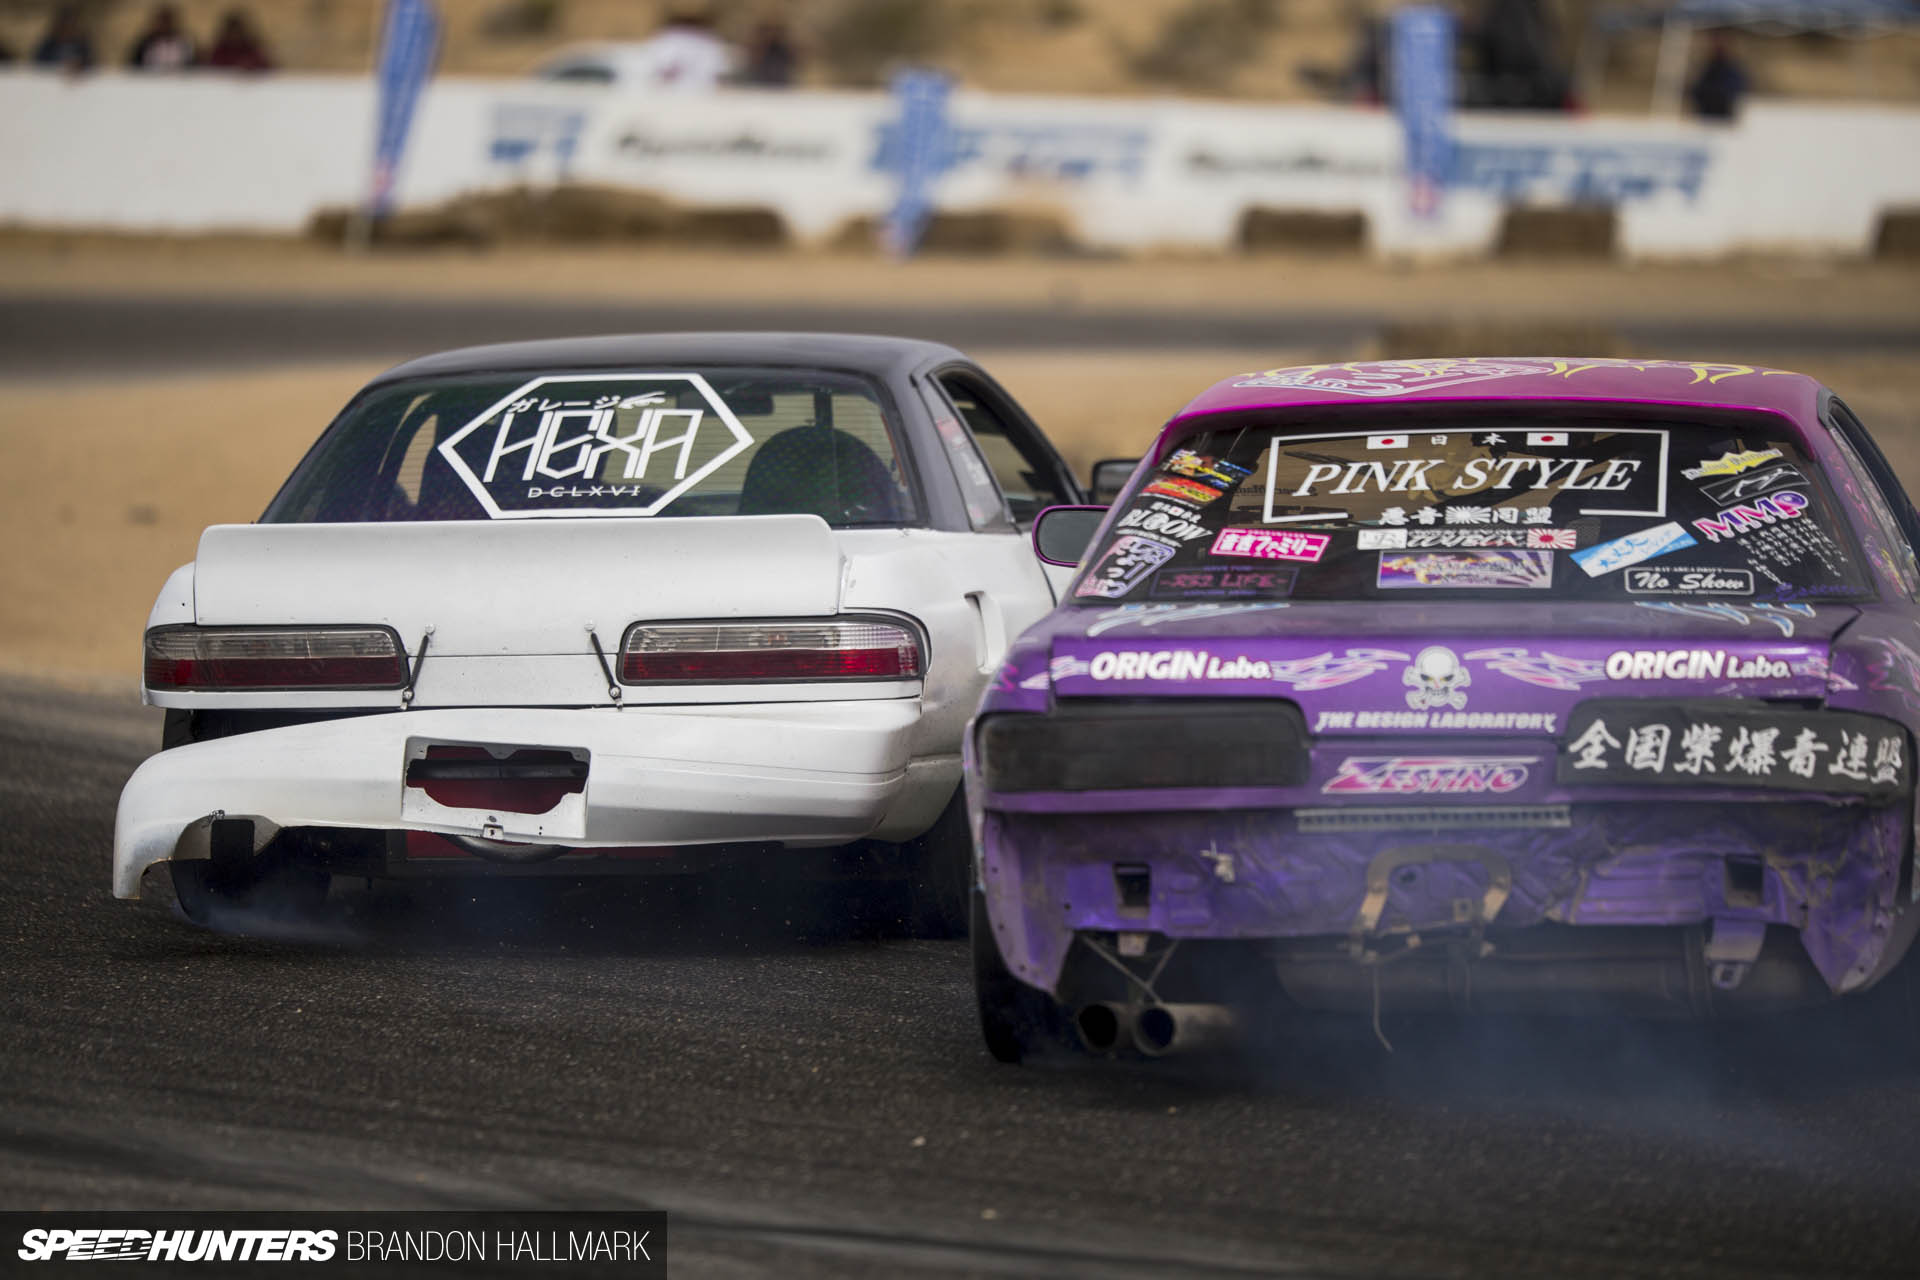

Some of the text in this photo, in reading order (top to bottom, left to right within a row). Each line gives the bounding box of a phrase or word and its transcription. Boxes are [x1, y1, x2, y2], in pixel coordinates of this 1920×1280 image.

[483, 409, 704, 483] HEXA
[1291, 459, 1446, 498] PINK
[1452, 457, 1642, 492] STYLE
[1691, 490, 1809, 544] MMP
[1633, 571, 1745, 590] No Show
[1089, 651, 1272, 681] ORIGIN Labo.
[1605, 650, 1792, 680] ORIGIN Labo.
[1314, 711, 1557, 733] THE DESIGN LABORATORY
